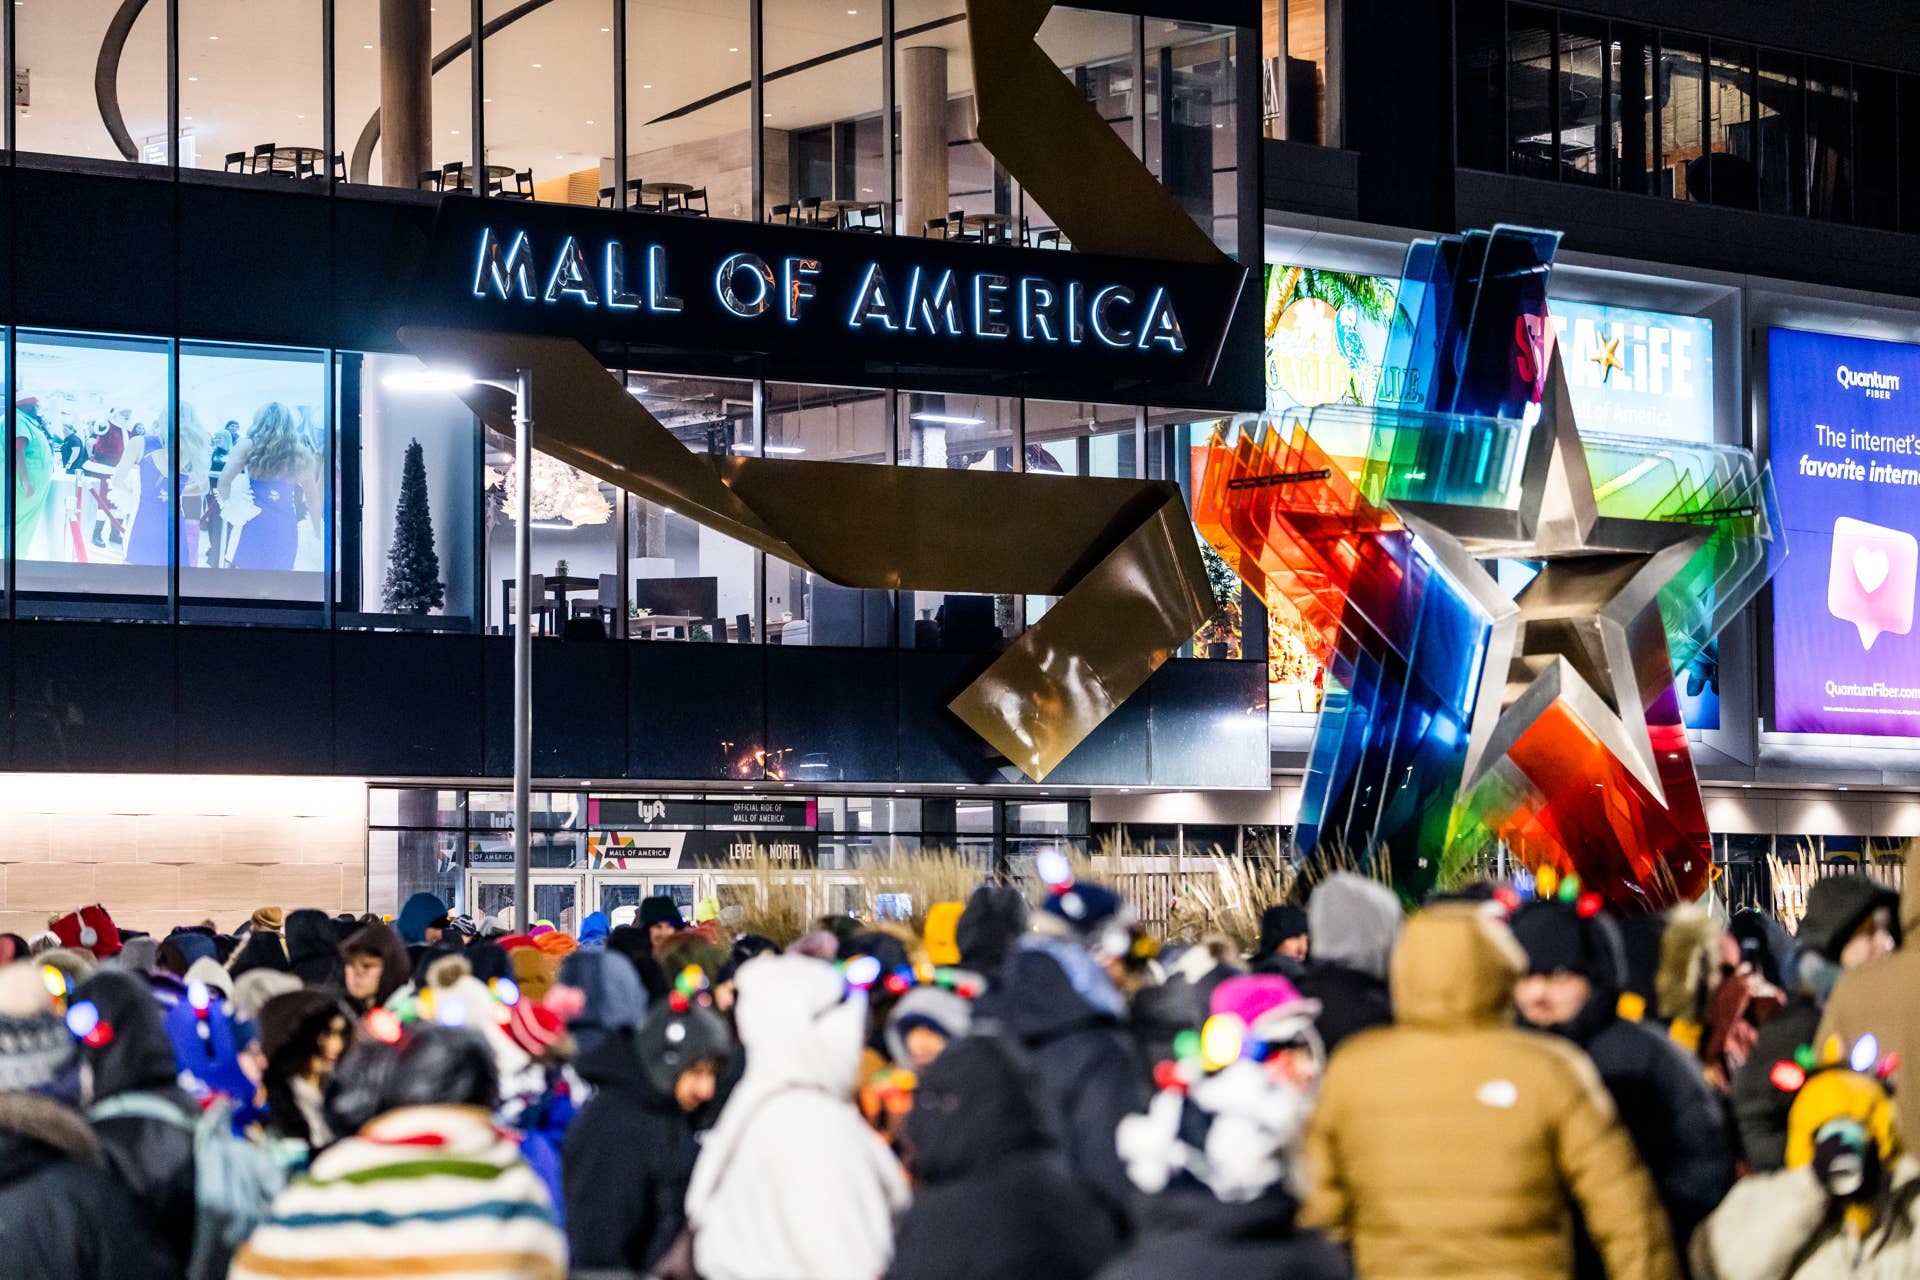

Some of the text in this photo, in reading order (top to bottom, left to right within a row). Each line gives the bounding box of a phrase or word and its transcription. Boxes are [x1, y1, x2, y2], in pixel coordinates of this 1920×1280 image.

[474, 228, 1188, 351] MALL OF AMERICA
[1515, 313, 1602, 388] SEA
[1836, 365, 1900, 390] Quantum
[1865, 388, 1891, 399] FIBER
[1574, 401, 1673, 427] all of America
[1815, 424, 1847, 448] The
[1799, 454, 1920, 485] favorite intern
[1825, 680, 1920, 698] QuantumFiber.com
[637, 799, 666, 823] lyft
[733, 803, 782, 812] OFFICIAL RIDE OF
[733, 814, 748, 822] MALL
[749, 814, 757, 822] OF
[484, 853, 513, 861] AMERICA
[608, 849, 667, 857] MALL OF AMERICA
[769, 844, 800, 860] NORTH
